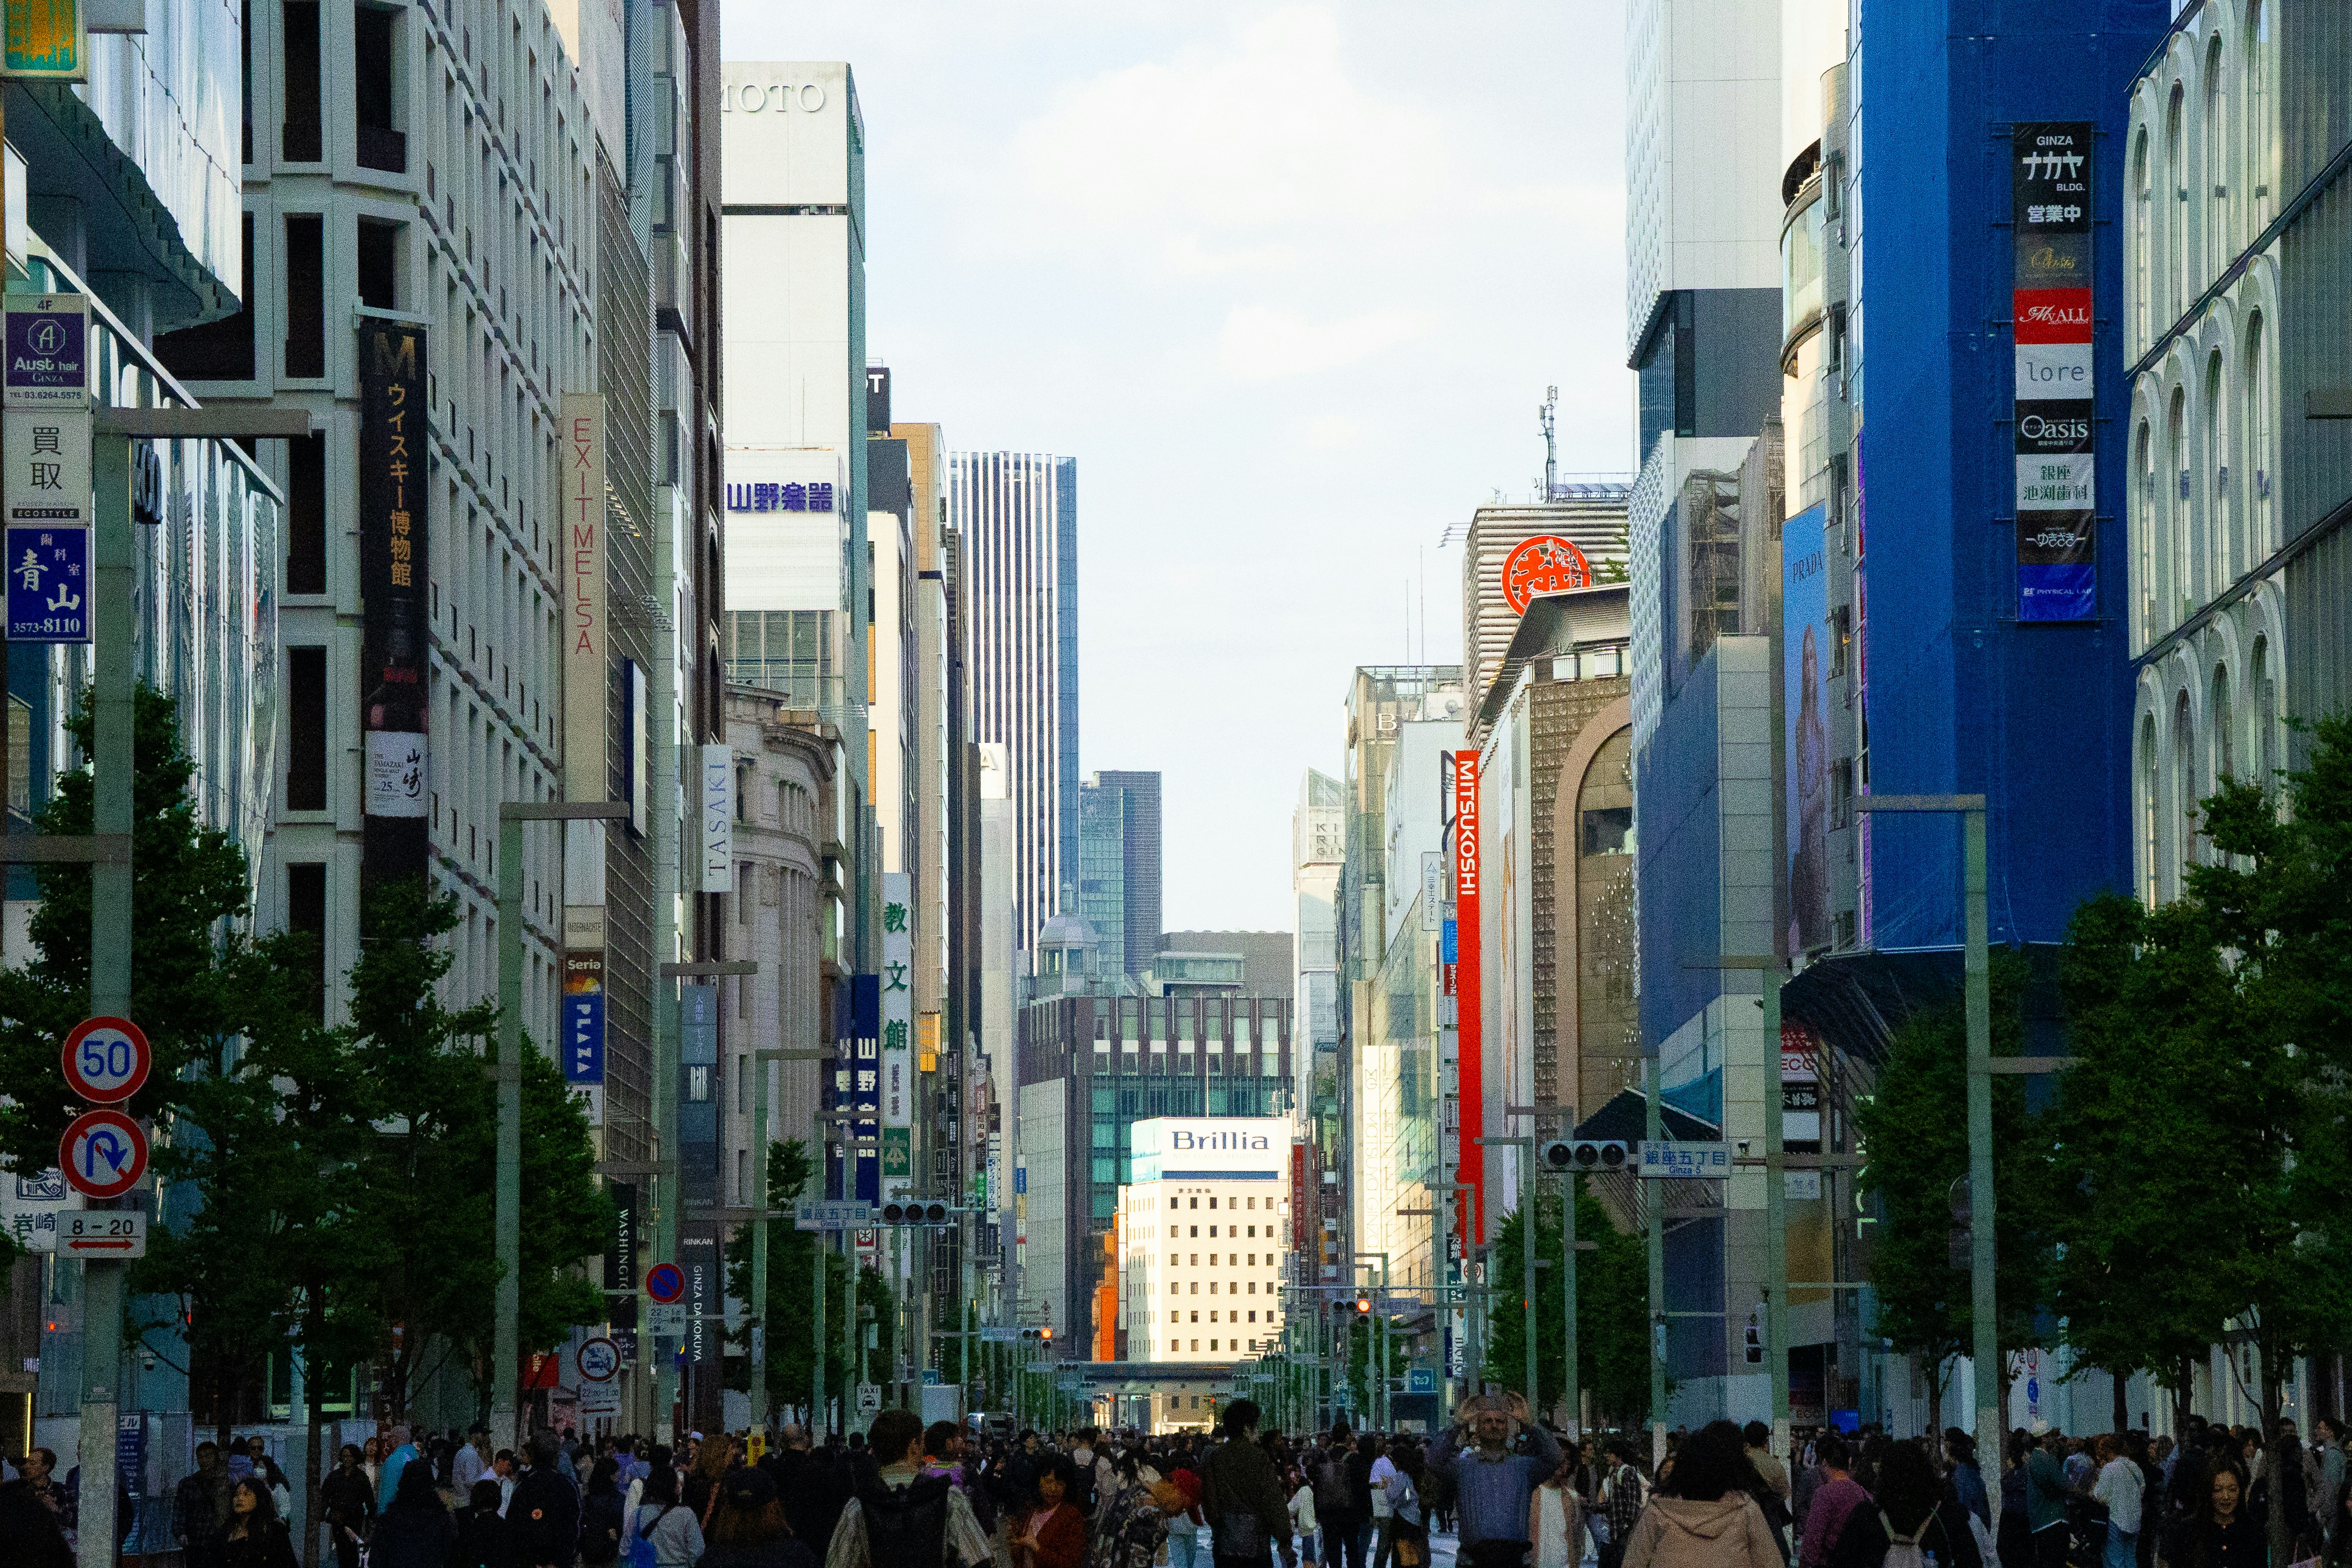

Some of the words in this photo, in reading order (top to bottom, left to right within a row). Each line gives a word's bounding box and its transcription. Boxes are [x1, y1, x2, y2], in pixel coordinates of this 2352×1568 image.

[2036, 135, 2073, 146] GINZA
[2022, 151, 2085, 180] ナカヤ
[2055, 183, 2086, 192] BLDG.
[2027, 204, 2082, 223] 営業中
[38, 300, 52, 310] 4F
[32, 373, 64, 382] GINZA
[59, 361, 78, 371] hair
[2026, 361, 2085, 381] lore
[2021, 415, 2089, 439] Oasis
[30, 427, 62, 490] 買取
[388, 382, 412, 587] ウイスキー博物館
[2041, 465, 2072, 481] 銀座
[727, 482, 833, 511] 山野楽器
[574, 417, 594, 655] EXITMELSA
[1792, 550, 1823, 584] PRADA
[13, 548, 80, 611] 青山
[13, 618, 80, 633] 3573-8110
[381, 782, 393, 791] 25
[708, 764, 727, 877] TASAKI
[1460, 760, 1476, 894] MITSUKOSHI
[568, 959, 602, 970] Seria
[884, 902, 908, 1050] 教文館
[576, 1003, 592, 1074] PLAZA
[84, 1041, 130, 1077] 50
[1171, 1131, 1270, 1150] Brillia
[1644, 1151, 1726, 1166] 銀座五丁目
[1669, 1166, 1692, 1175] Ginza
[693, 1265, 703, 1299] GINZA
[693, 1302, 703, 1362] DAKOKUYA
